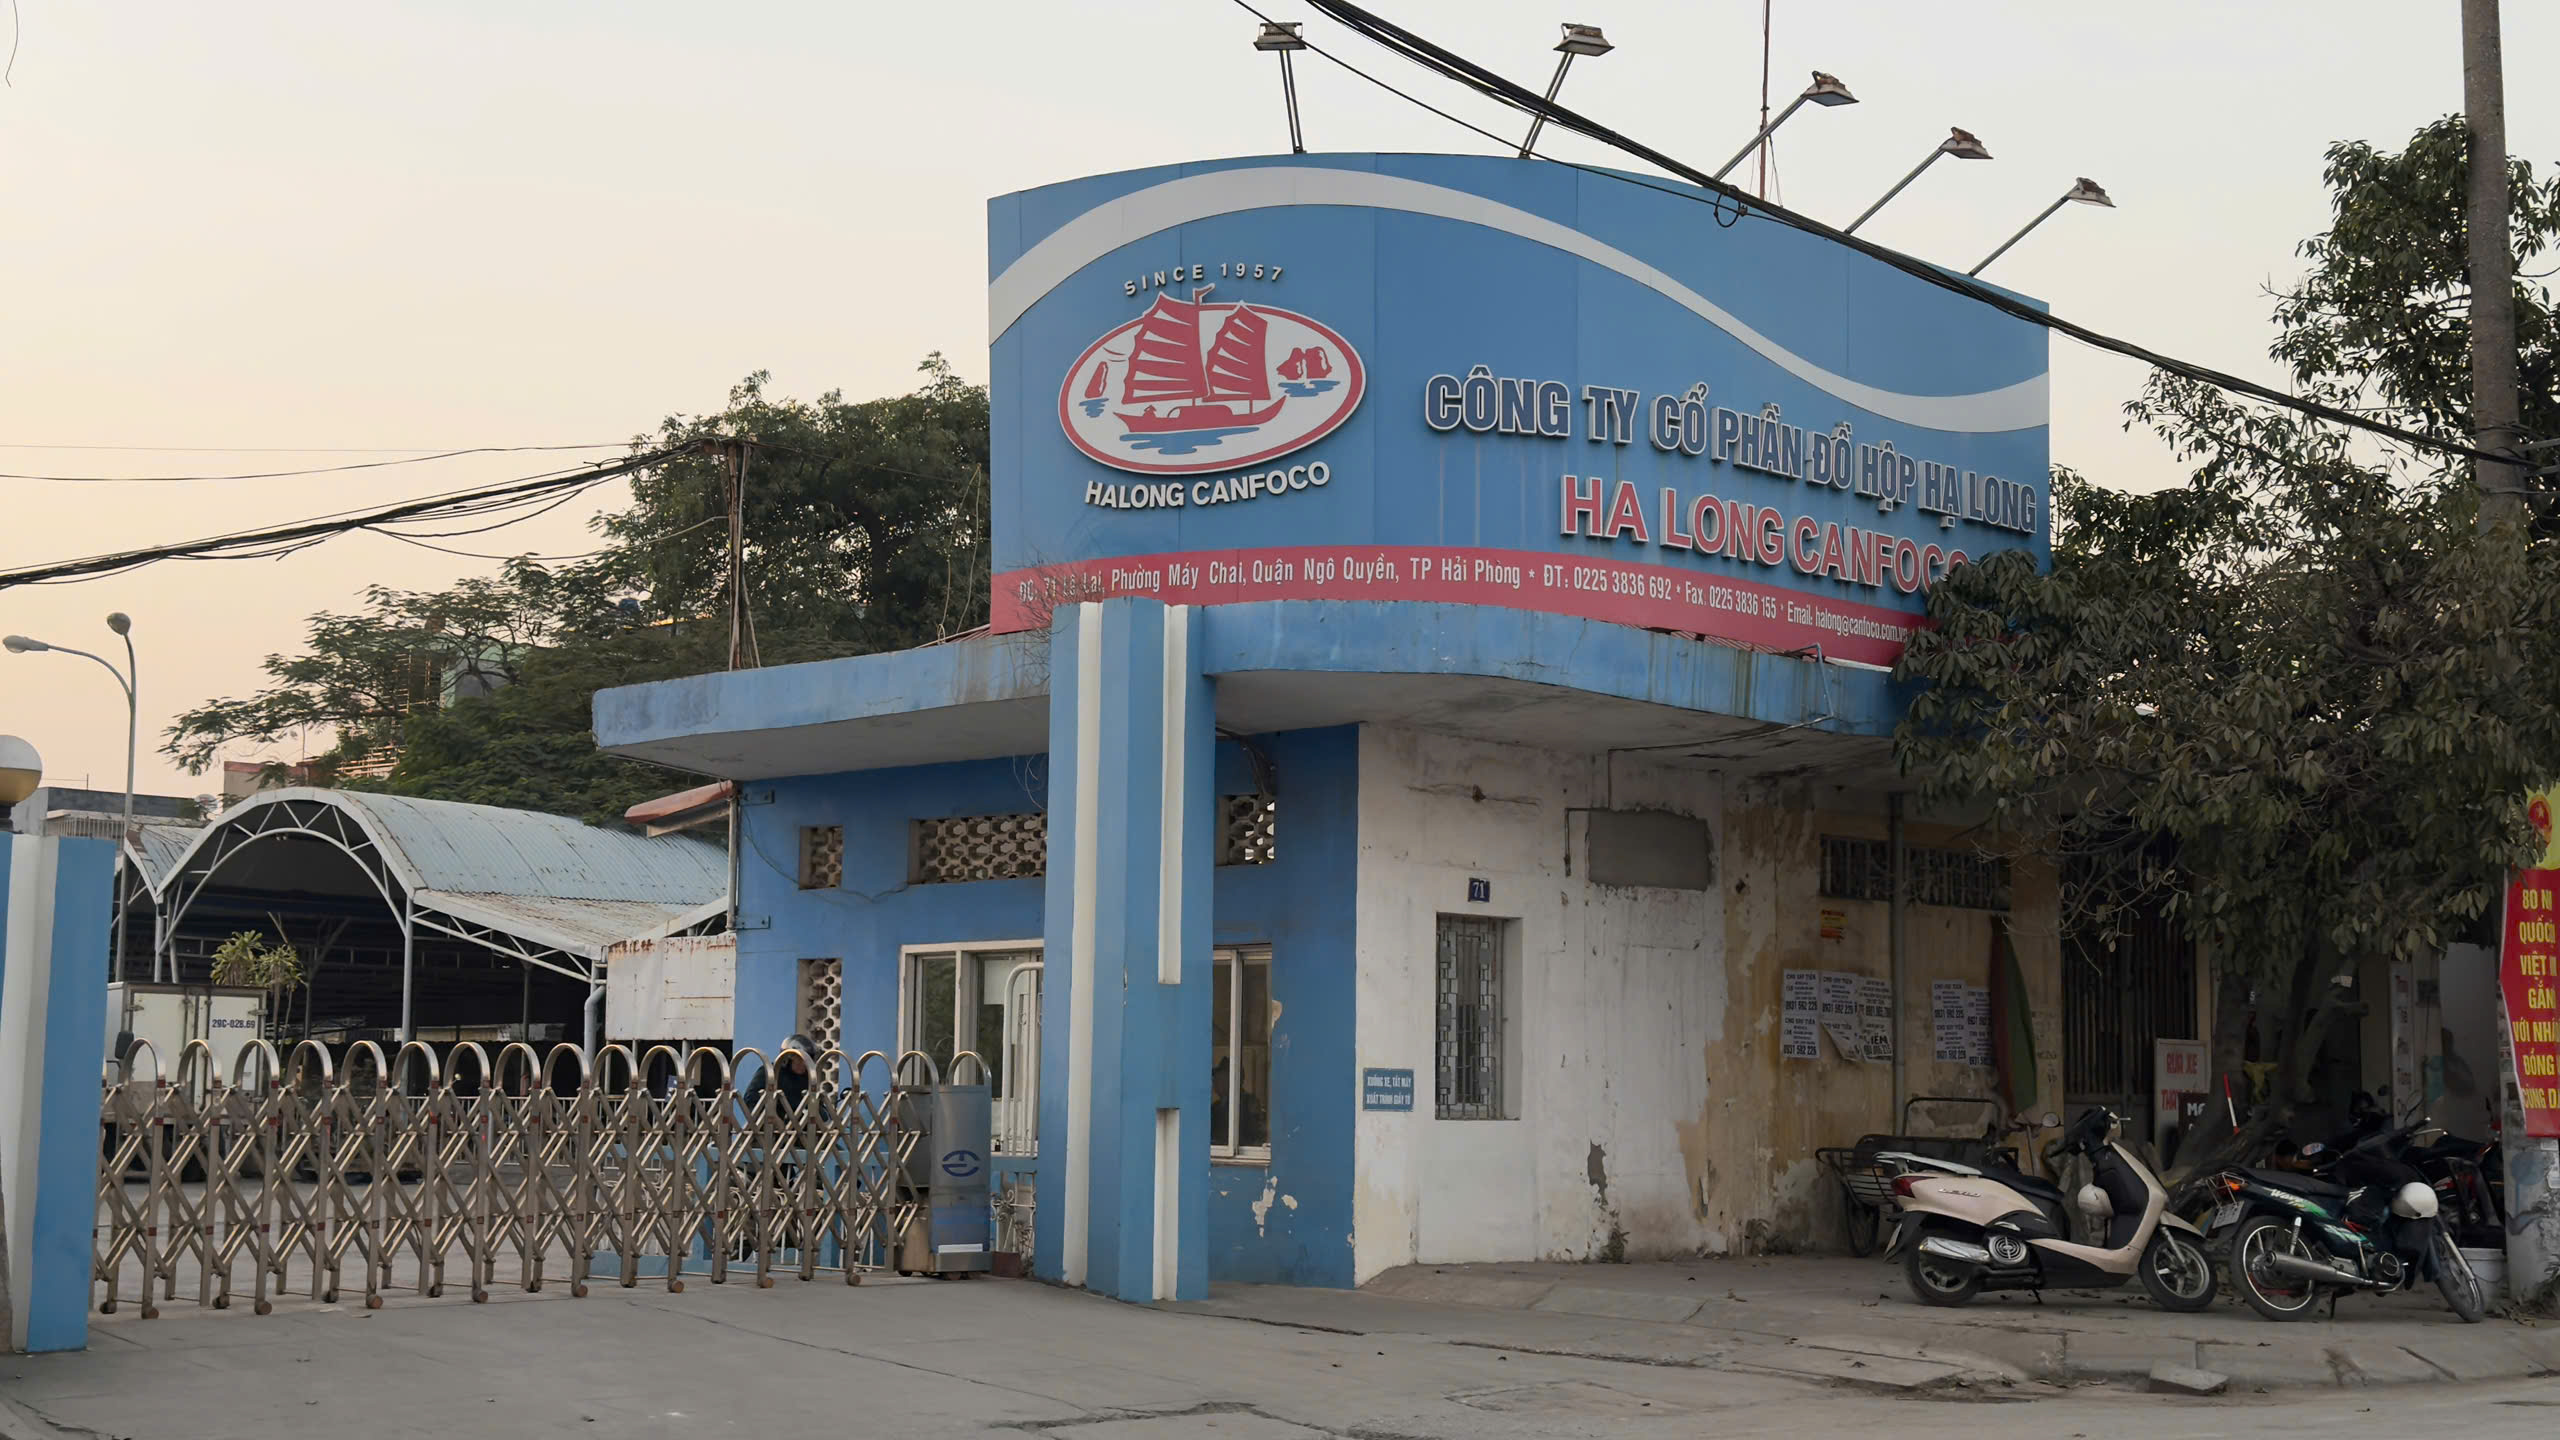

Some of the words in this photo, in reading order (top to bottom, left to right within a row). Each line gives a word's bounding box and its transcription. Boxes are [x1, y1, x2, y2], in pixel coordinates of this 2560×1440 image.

[1124, 264, 1204, 296] SINCE
[1220, 263, 1284, 282] 1957
[1426, 364, 1570, 437] CÔNG
[1582, 384, 1640, 444] TY
[1650, 382, 1708, 456] CỔ
[1711, 402, 1802, 480] PHẦN
[1805, 421, 1852, 491] ĐỒ
[1855, 440, 1916, 512] HỘP
[1918, 460, 1961, 528] HẠ
[1962, 470, 2037, 535] LONG
[1084, 480, 1184, 508] HALONG
[1192, 461, 1330, 506] CANFOCO
[1560, 474, 1649, 543] HA
[1660, 487, 1784, 566] LONG
[1112, 564, 1160, 592] Phường
[1169, 562, 1199, 589] Máy
[1209, 560, 1246, 586] Chai,
[1252, 558, 1293, 585] Quận
[1304, 557, 1335, 585] Ngô
[1343, 553, 1400, 583] Quyền,
[1410, 557, 1432, 580] TP
[1441, 556, 1467, 581] Hải
[1475, 559, 1520, 589] Phòng
[1543, 564, 1569, 588] ĐT:
[1574, 567, 1608, 592] 0225
[1612, 570, 1645, 596] 3836
[1649, 576, 1672, 600] 692
[1709, 585, 1733, 611] 0225
[1735, 592, 1759, 616] 3836
[1761, 595, 1777, 619] 155
[1787, 601, 1813, 627] Email:
[1472, 881, 1485, 899] 71
[2522, 888, 2538, 910] 80
[2520, 950, 2547, 980] VIỆT
[2512, 1016, 2531, 1042] VỚI
